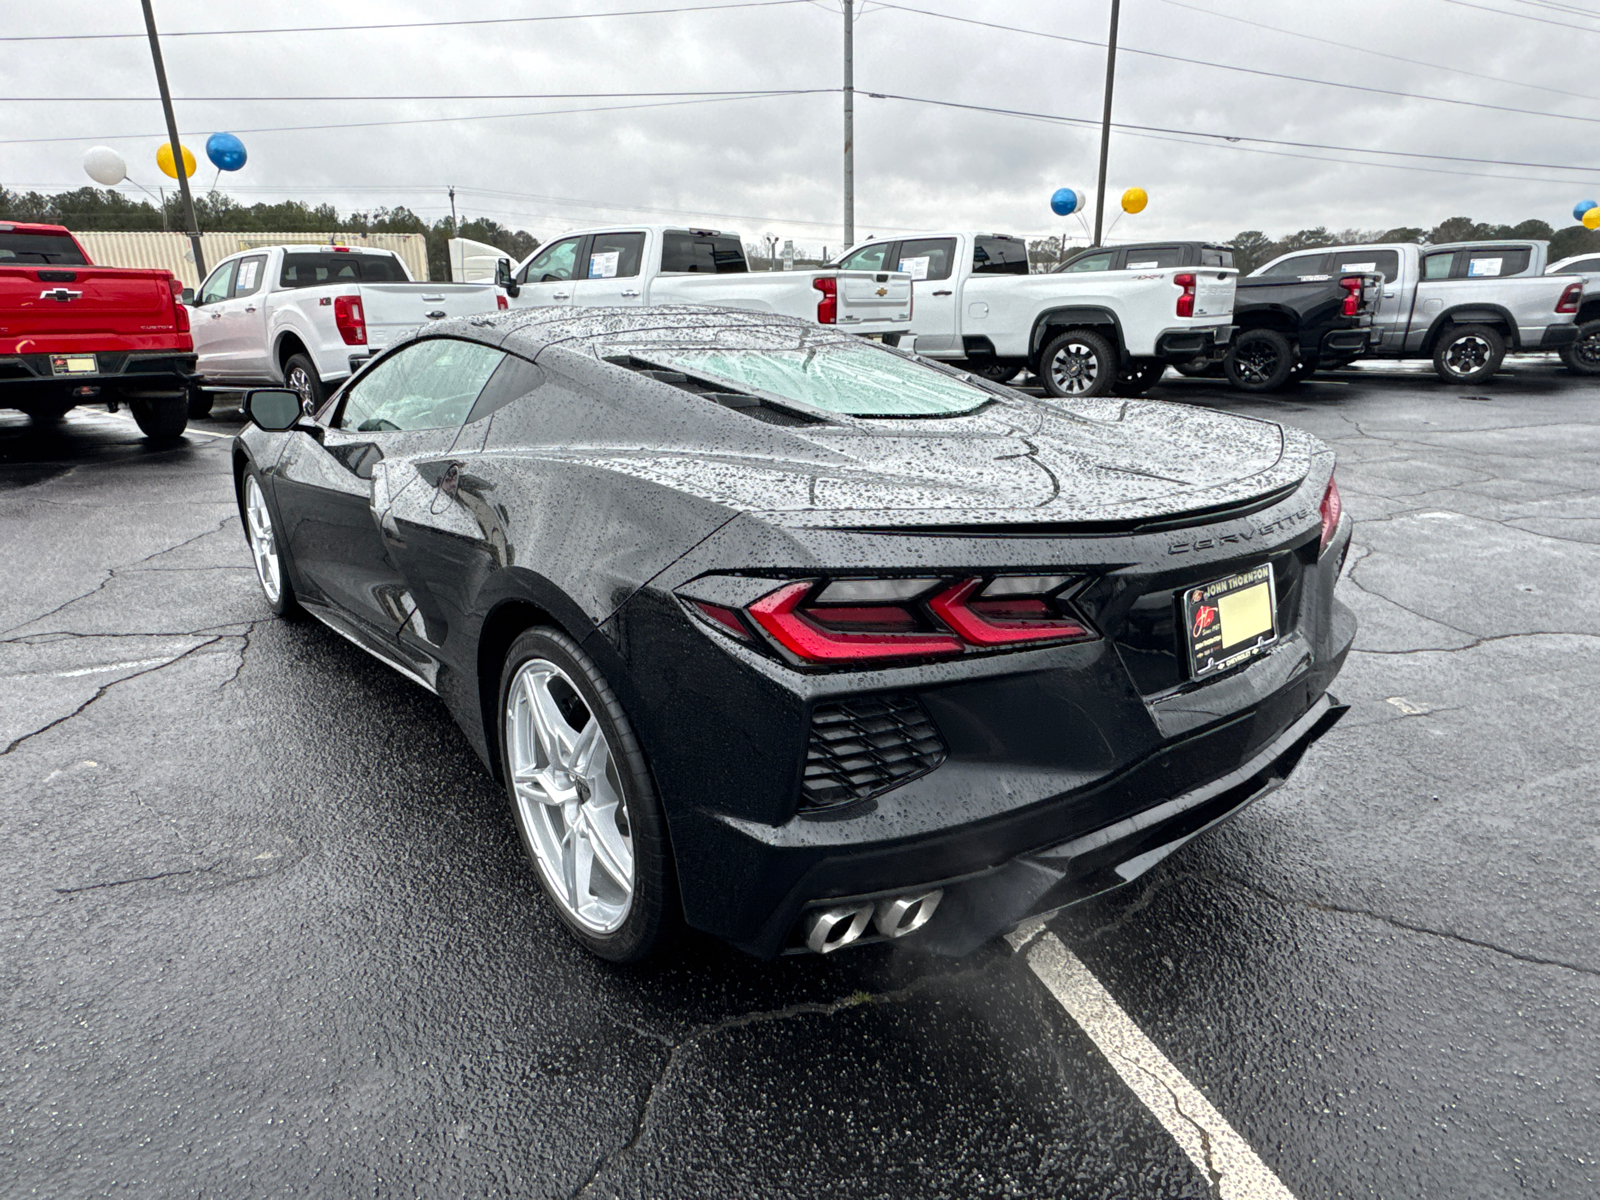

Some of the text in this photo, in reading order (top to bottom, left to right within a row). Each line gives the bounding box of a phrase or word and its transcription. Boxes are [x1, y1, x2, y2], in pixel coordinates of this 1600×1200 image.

[1167, 508, 1311, 555] CORVETTE
[1204, 566, 1269, 597] JOHN THORNTON
